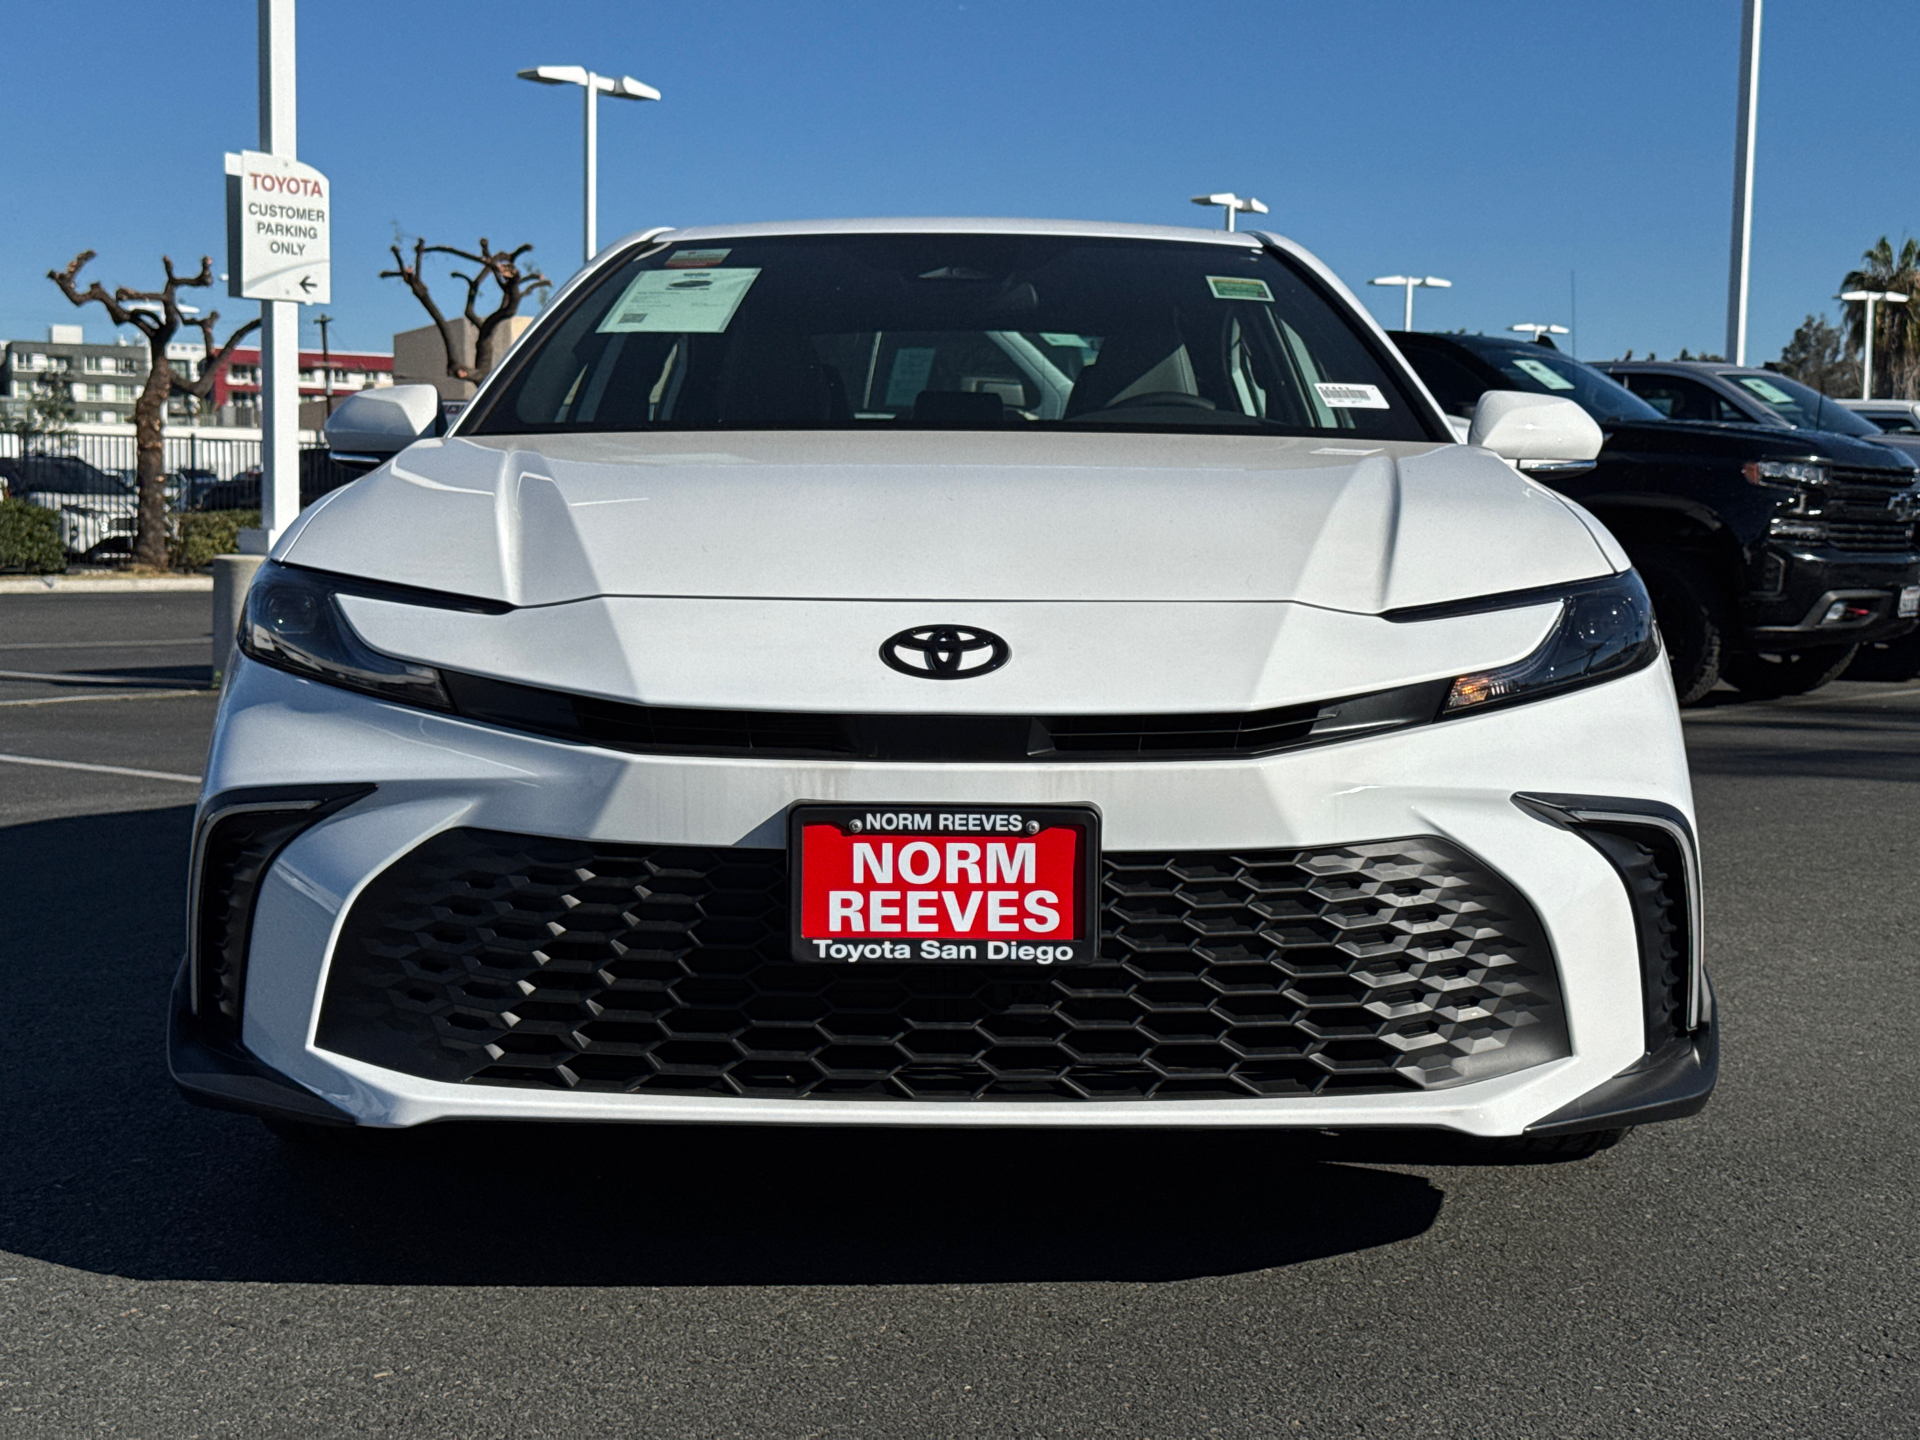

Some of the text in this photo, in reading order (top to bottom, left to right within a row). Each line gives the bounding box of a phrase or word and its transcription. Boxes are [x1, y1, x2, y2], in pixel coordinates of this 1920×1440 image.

[249, 172, 324, 198] TOYOTA
[248, 202, 326, 222] CUSTOMER
[256, 221, 318, 240] PARKING
[269, 241, 306, 256] ONLY
[865, 813, 1023, 832] NORM REEVES
[852, 841, 1037, 885] NORM
[828, 890, 1061, 933] REEVES
[812, 939, 1074, 965] Toyota San Diego
